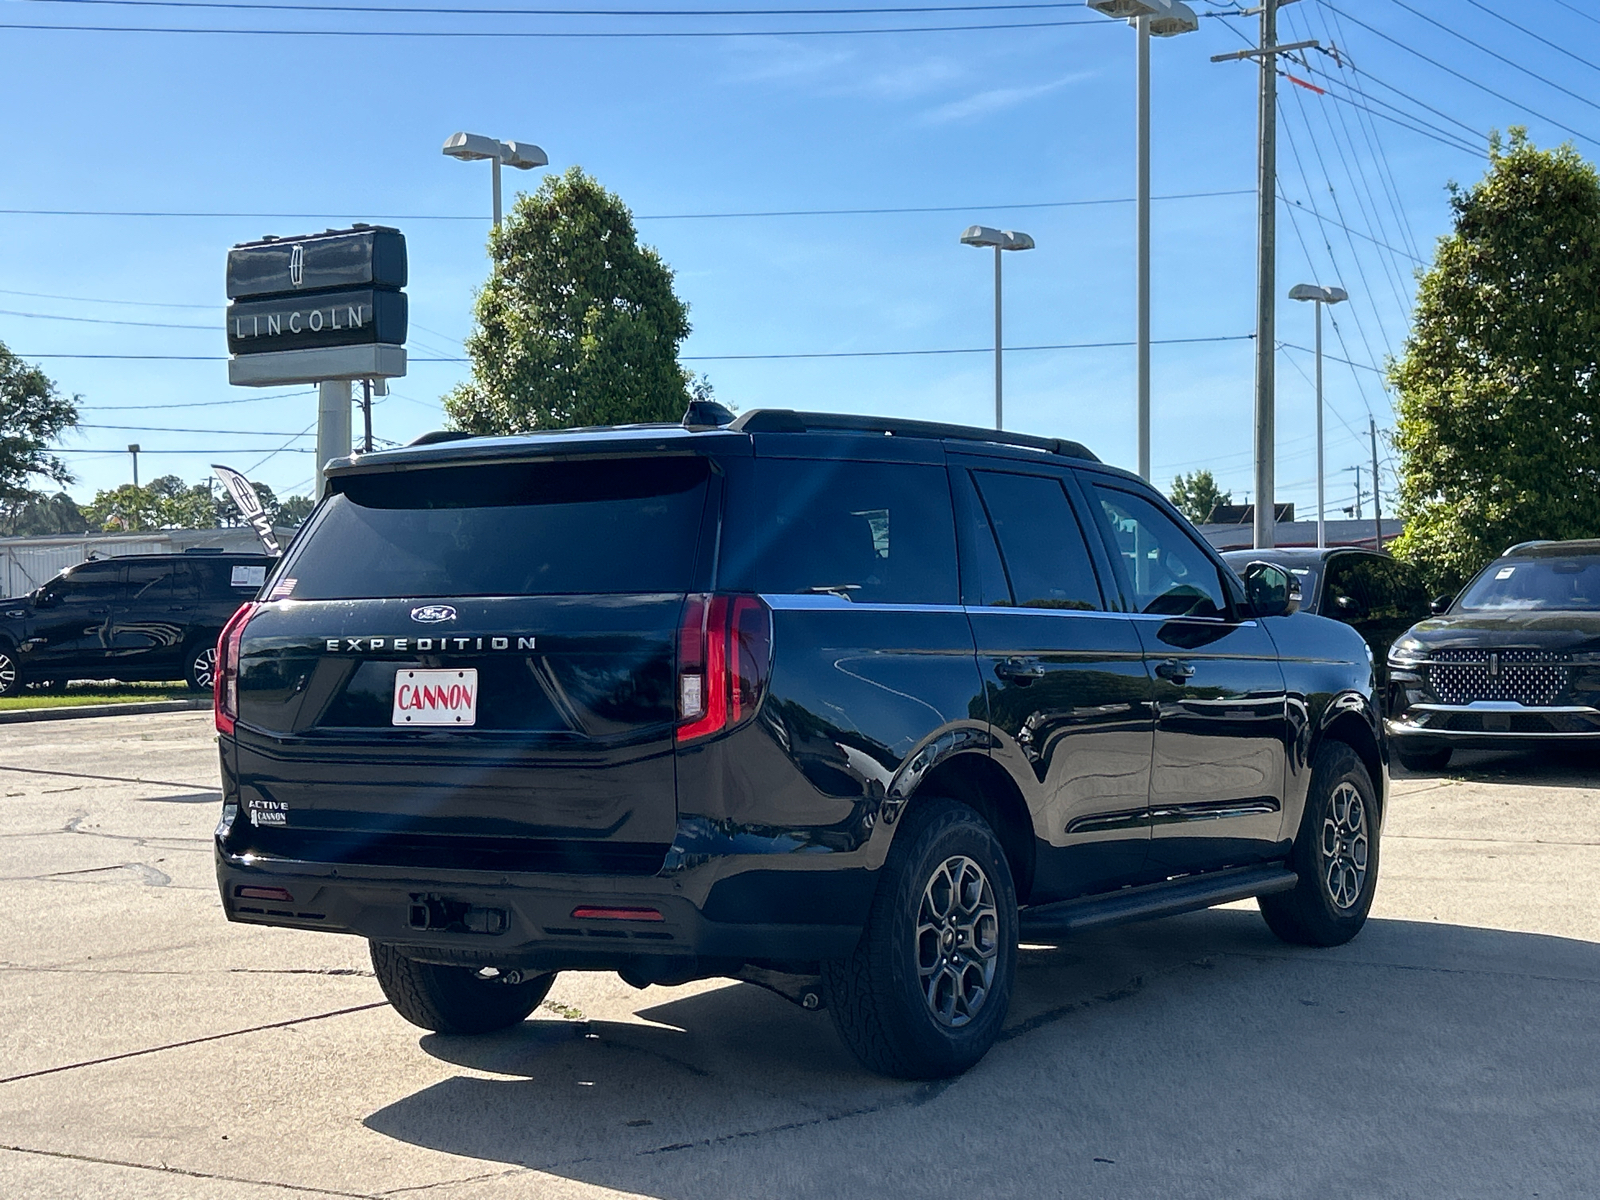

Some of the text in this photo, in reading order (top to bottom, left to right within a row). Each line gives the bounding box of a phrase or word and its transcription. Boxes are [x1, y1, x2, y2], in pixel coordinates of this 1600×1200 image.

[236, 305, 363, 339] LINCOLN
[326, 637, 536, 652] EXPEDITION
[398, 684, 473, 710] CANNON
[248, 800, 289, 811] ACTIVE
[257, 811, 286, 821] CANNON
